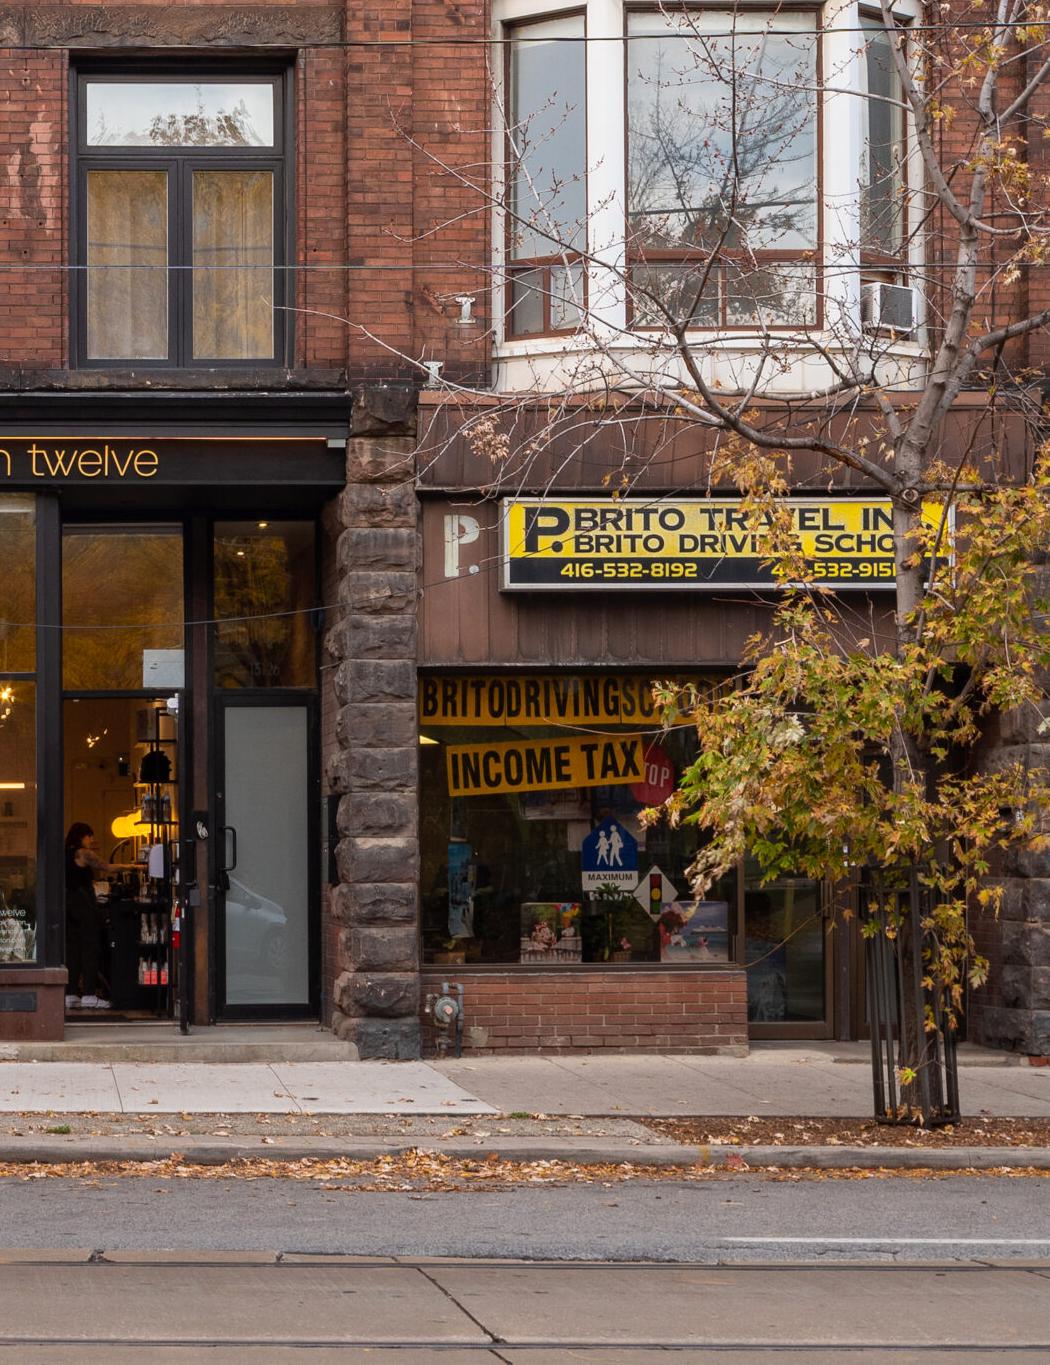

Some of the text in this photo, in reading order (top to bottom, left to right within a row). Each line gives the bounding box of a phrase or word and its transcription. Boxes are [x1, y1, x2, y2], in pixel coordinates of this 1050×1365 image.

[27, 444, 159, 477] twelve
[524, 507, 570, 553] P.
[573, 508, 685, 531] BRITO
[573, 534, 665, 553] BRITO
[560, 562, 698, 577] 416-532-8192
[451, 740, 641, 790] INCOME TAX
[587, 873, 633, 881] MAXIMUM
